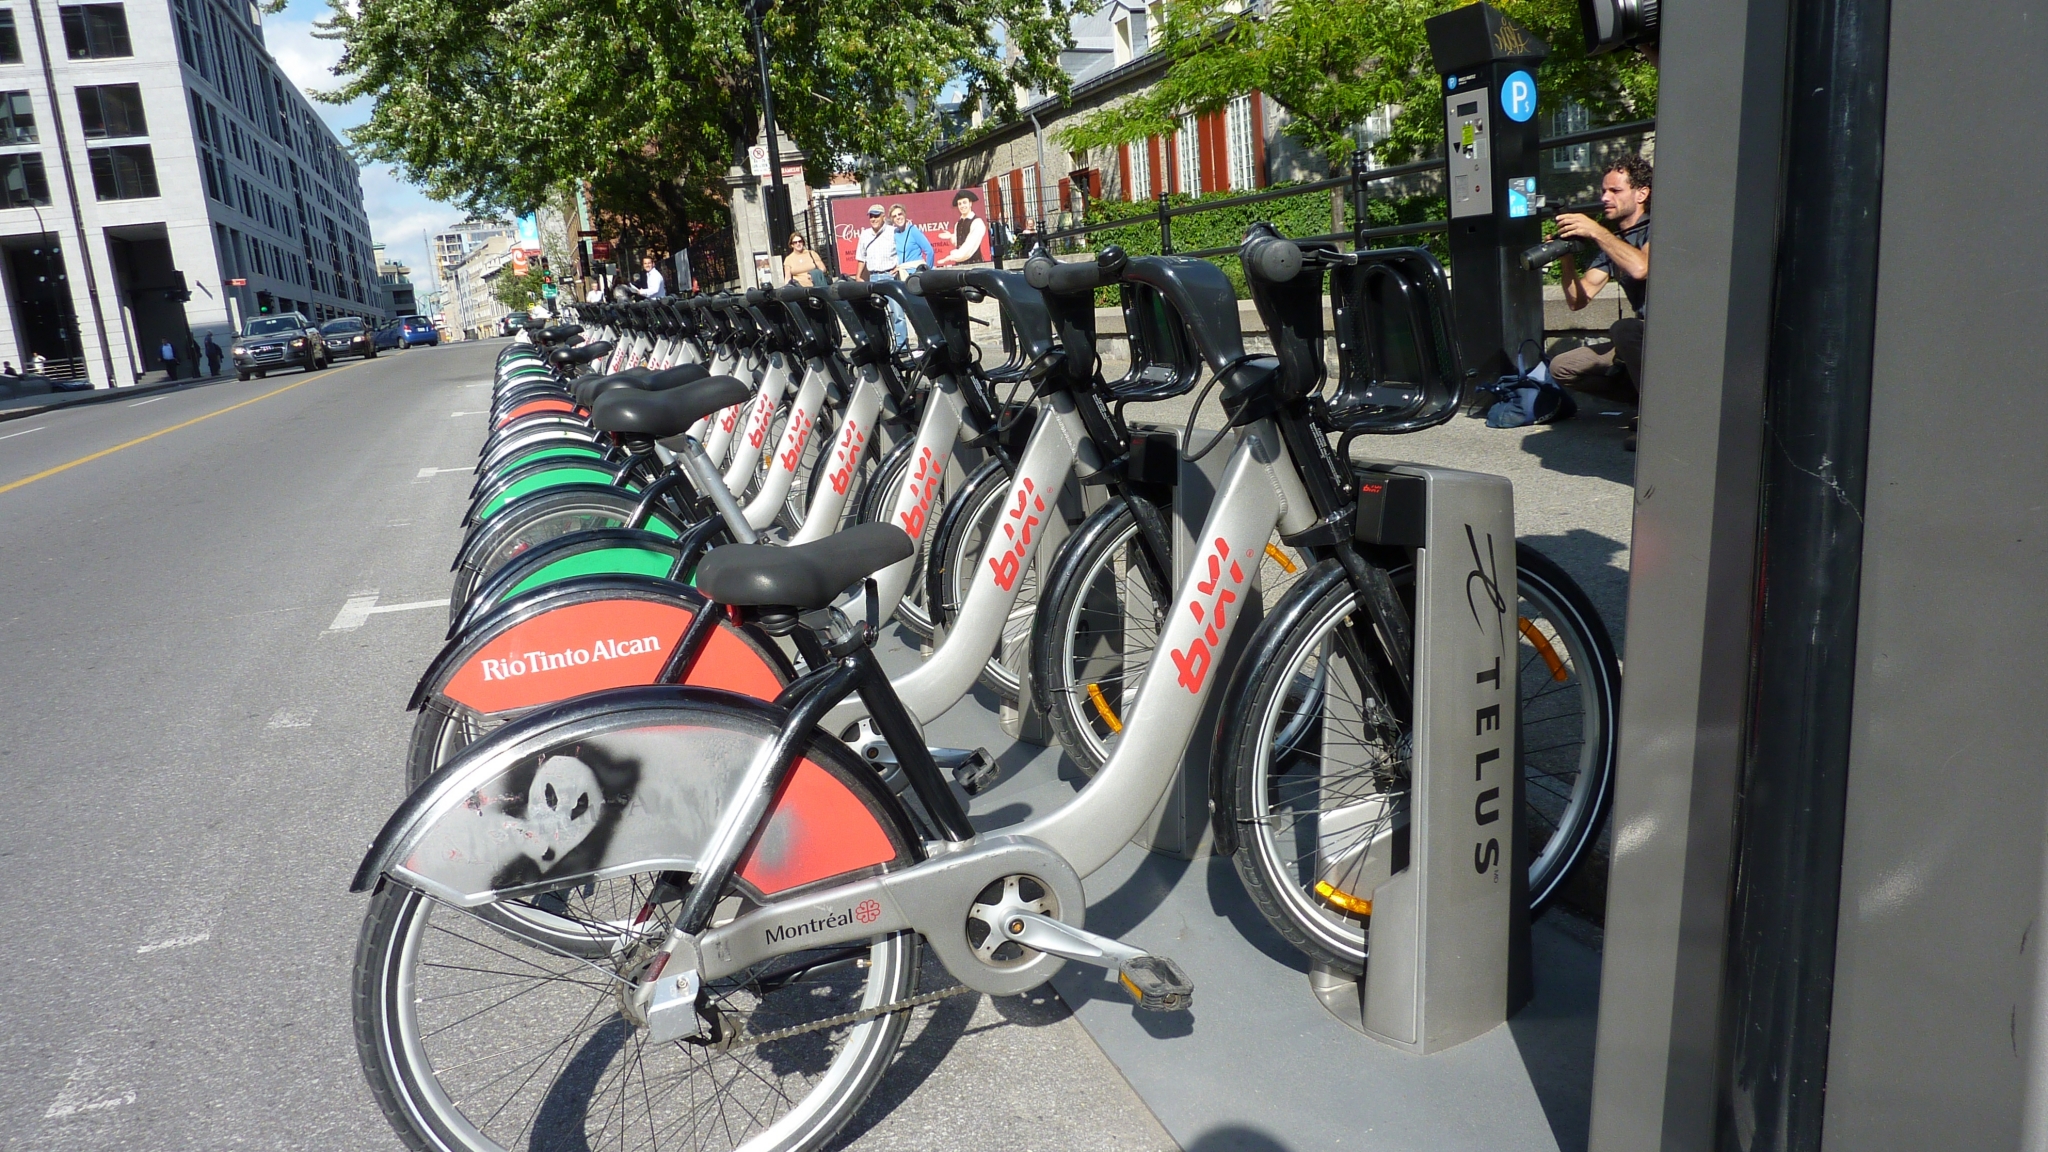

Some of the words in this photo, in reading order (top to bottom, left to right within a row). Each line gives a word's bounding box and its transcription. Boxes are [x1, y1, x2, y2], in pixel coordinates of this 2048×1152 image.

[907, 219, 949, 232] MEZAY
[989, 477, 1045, 591] bixi
[1171, 537, 1244, 695] bixi
[481, 658, 526, 681] Rio
[524, 648, 590, 673] Tinto
[592, 635, 661, 662] Alcan
[1475, 657, 1500, 875] TELUS
[765, 908, 853, 945] Montréal
